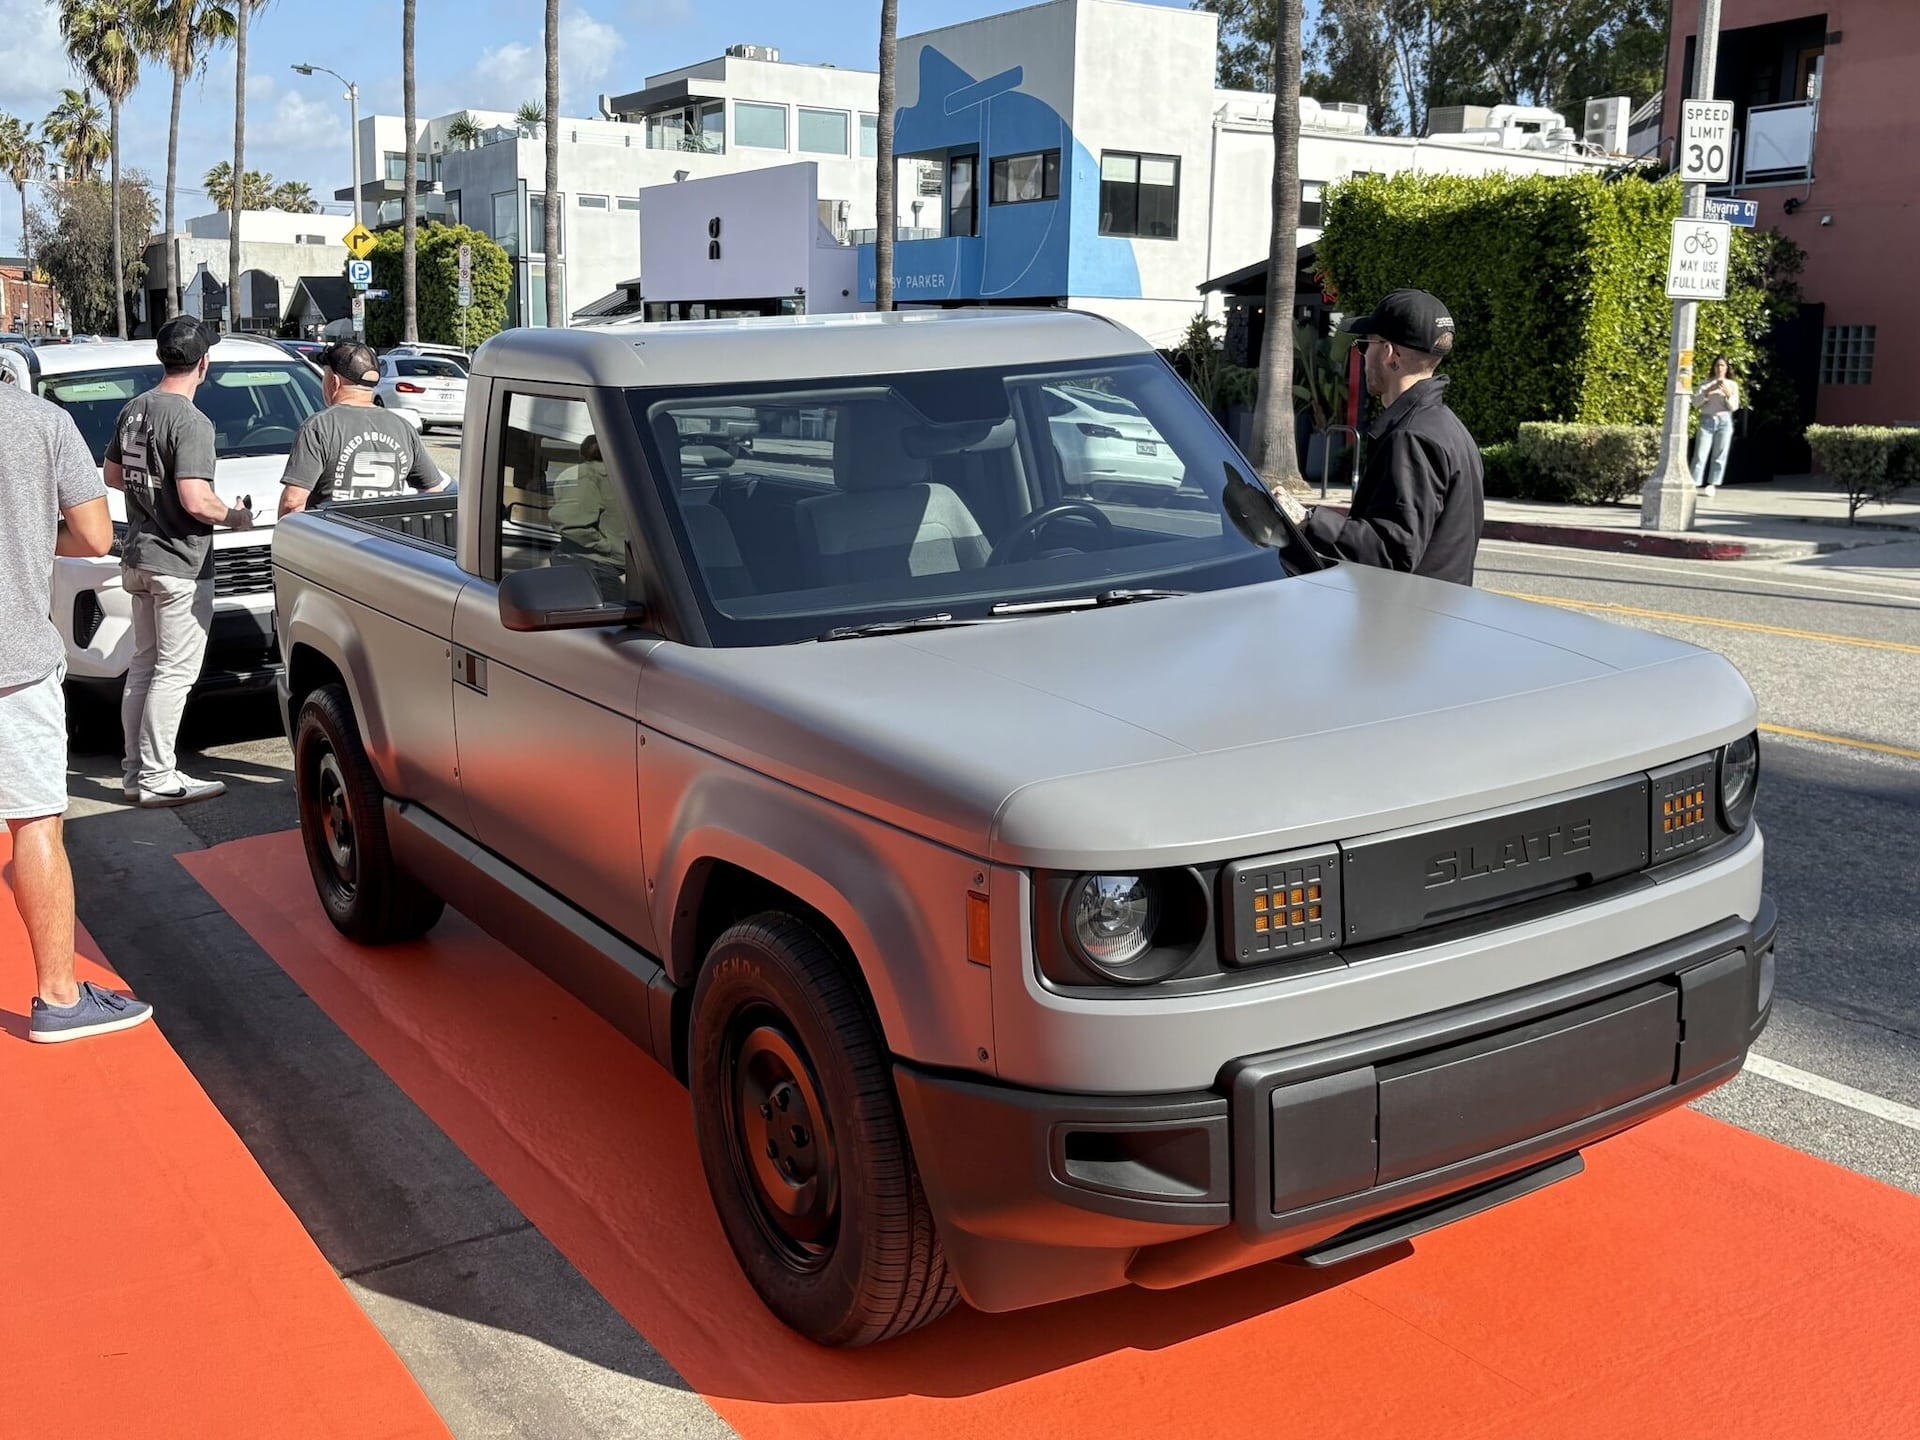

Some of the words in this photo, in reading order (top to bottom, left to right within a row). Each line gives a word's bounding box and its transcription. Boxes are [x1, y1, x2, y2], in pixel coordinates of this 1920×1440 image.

[1686, 108, 1729, 121] SPEED
[1690, 126, 1724, 139] LIMIT
[1686, 144, 1724, 174] 30
[1705, 199, 1740, 215] Navarre
[1744, 202, 1755, 217] Ct
[1679, 259, 1698, 272] MAY
[1702, 261, 1718, 274] USE
[868, 276, 902, 290] WBY
[906, 274, 945, 289] PARKER
[1672, 276, 1697, 290] FULL
[1700, 277, 1721, 291] LANE
[334, 435, 363, 487] DESIGNED
[371, 431, 401, 451] BUILT
[1424, 818, 1592, 890] SLATE
[712, 955, 762, 980] KENDA
